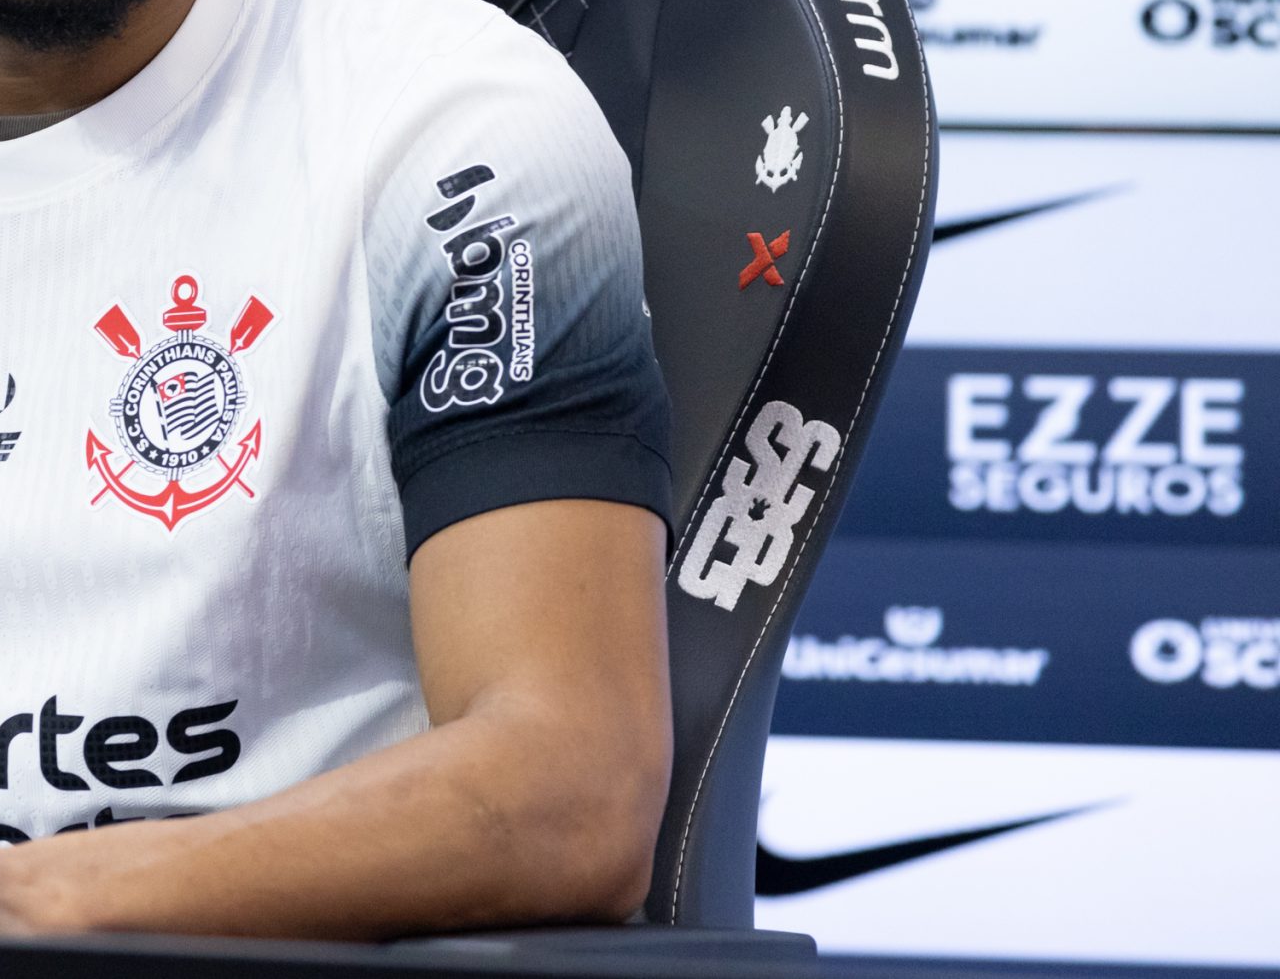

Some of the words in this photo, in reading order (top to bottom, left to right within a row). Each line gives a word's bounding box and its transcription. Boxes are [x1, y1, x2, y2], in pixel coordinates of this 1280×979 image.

[419, 216, 518, 412] bmg
[508, 239, 535, 383] CORINTHIANS
[124, 343, 218, 418] CORINTHIANS
[210, 361, 239, 443] PAULISTA
[947, 374, 1245, 466] EZZE
[161, 452, 199, 467] 1910
[948, 462, 1245, 516] SEGUROS
